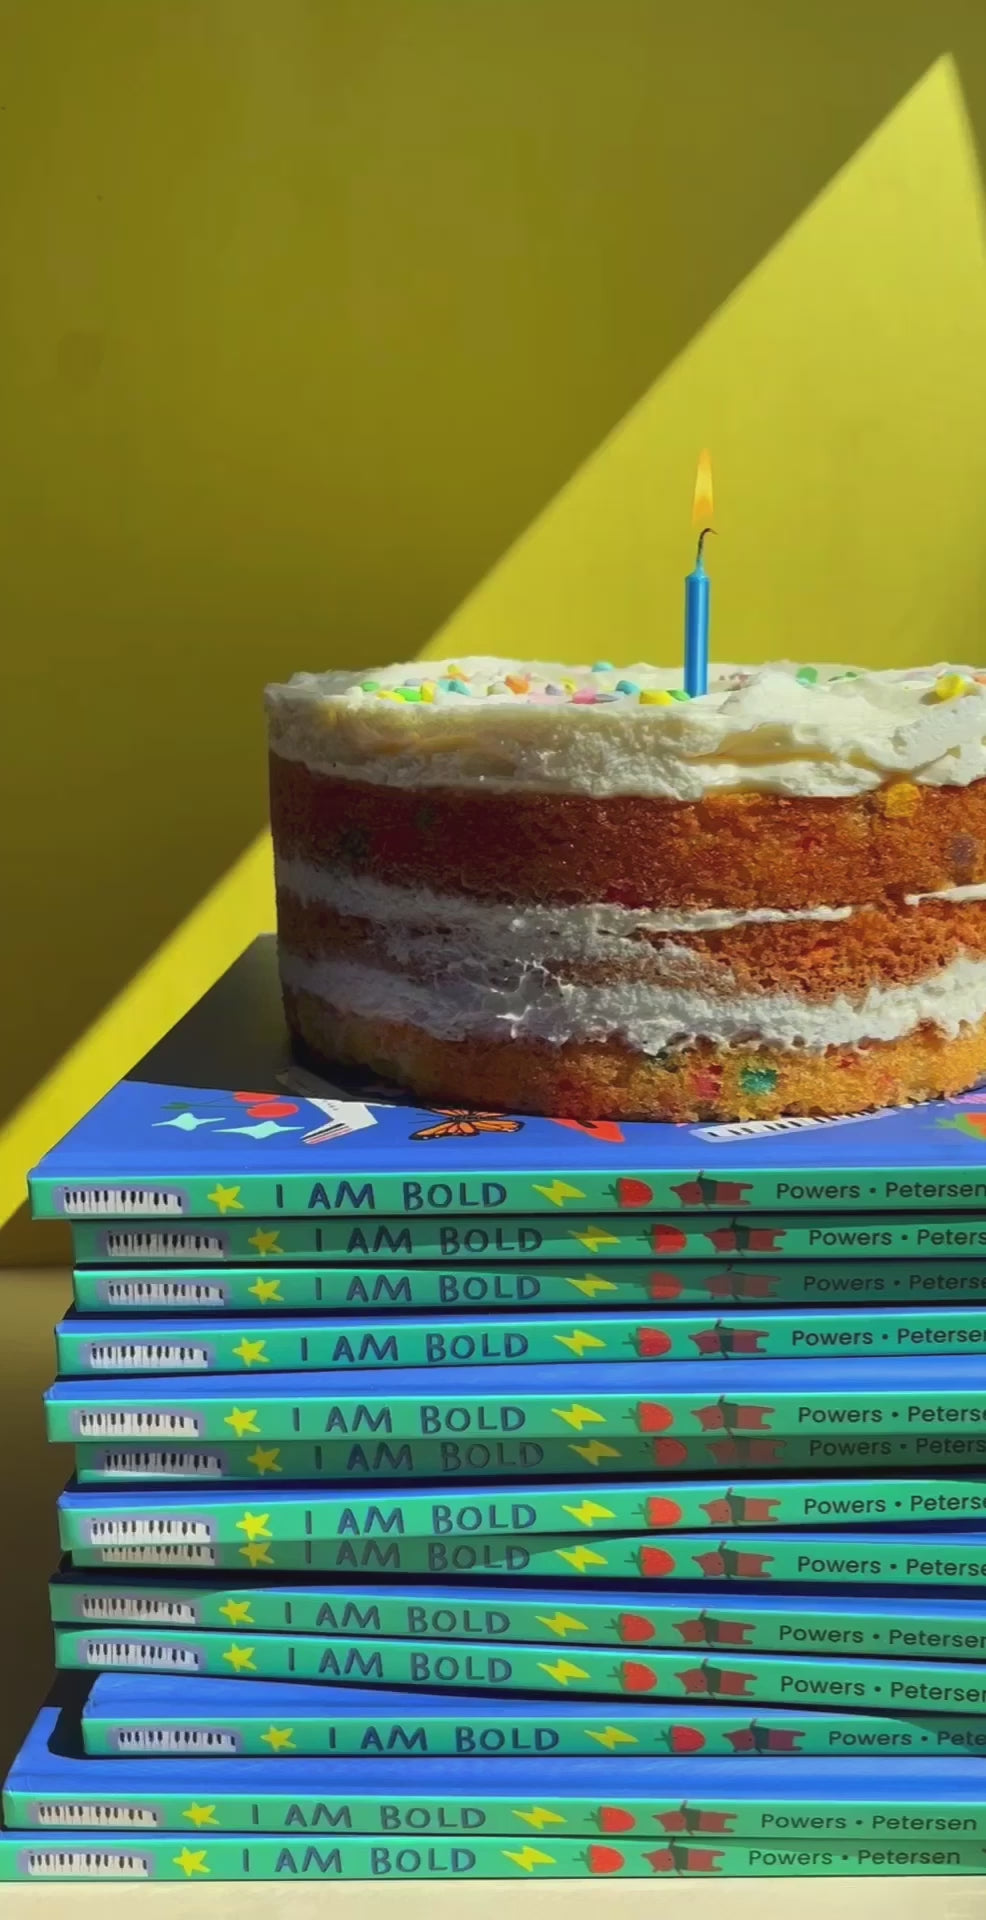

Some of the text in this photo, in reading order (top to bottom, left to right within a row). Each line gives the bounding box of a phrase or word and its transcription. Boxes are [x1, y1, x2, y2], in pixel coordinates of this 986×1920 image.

[276, 1181, 507, 1212] I AM BOLD
[777, 1181, 986, 1199] Powers Petersen
[315, 1225, 543, 1255] I AM BOLD
[809, 1229, 892, 1246] Powers
[315, 1274, 541, 1302] I AM BOLD
[803, 1275, 885, 1292] Powers
[301, 1333, 529, 1362] I AM BOLD
[792, 1327, 986, 1346] Powers Peterse
[292, 1404, 526, 1434] I AM BOLD
[798, 1405, 986, 1423] Powers Peters
[314, 1441, 544, 1471] I AM BOLD
[810, 1439, 892, 1456] Powers
[804, 1494, 986, 1515] Powers Peters
[305, 1504, 537, 1535] I AM BOLD
[305, 1539, 530, 1572] I AM BOLD
[797, 1556, 881, 1574] Powers
[285, 1602, 510, 1634] I AM BOLD
[779, 1625, 864, 1643] Powers
[288, 1647, 512, 1683] I AM BOLD
[780, 1675, 986, 1703] Powers Peterse
[328, 1725, 560, 1752] I AM BOLD
[828, 1730, 912, 1746] Powers
[252, 1803, 486, 1829] I AM BOLD
[761, 1814, 977, 1831] Powers Petersen
[242, 1845, 476, 1875] I AM BOLD
[749, 1849, 960, 1866] Powers Petersen
